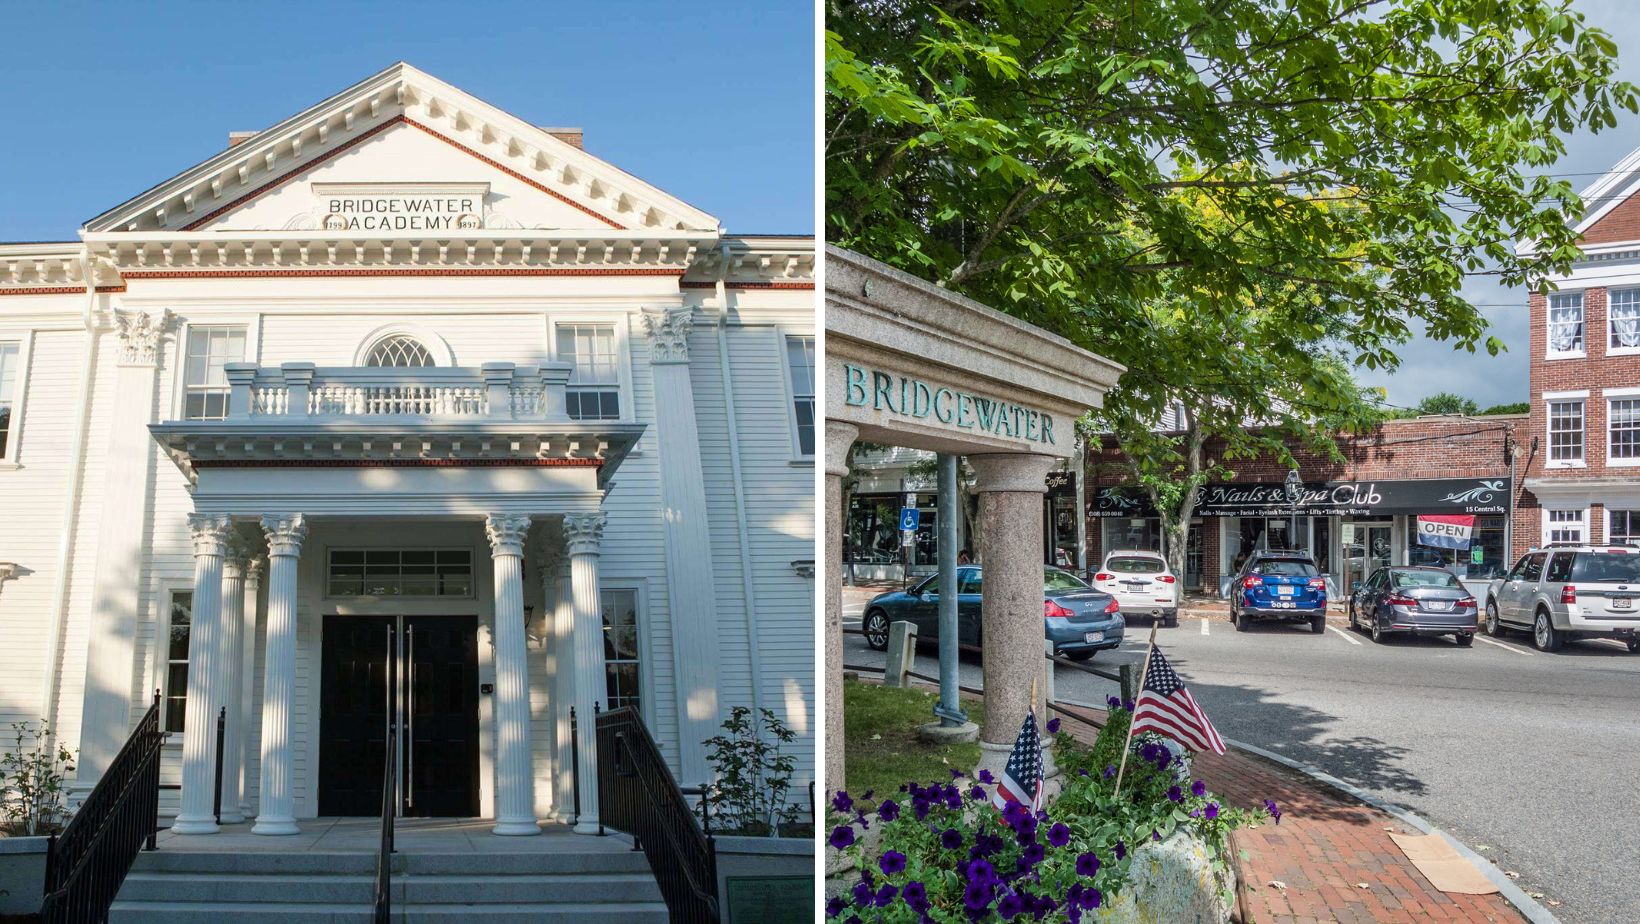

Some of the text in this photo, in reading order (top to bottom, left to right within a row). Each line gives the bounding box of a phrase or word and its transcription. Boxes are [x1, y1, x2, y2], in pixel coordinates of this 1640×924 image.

[329, 199, 473, 213] BRIDGEWATER
[349, 216, 453, 230] ACADEMY
[843, 363, 1056, 445] BRIDGEWATER
[1208, 486, 1266, 503] Nails
[1267, 488, 1284, 502] &
[1331, 483, 1382, 505] Club
[1496, 505, 1506, 513] Sq.
[1424, 522, 1465, 537] OPEN
